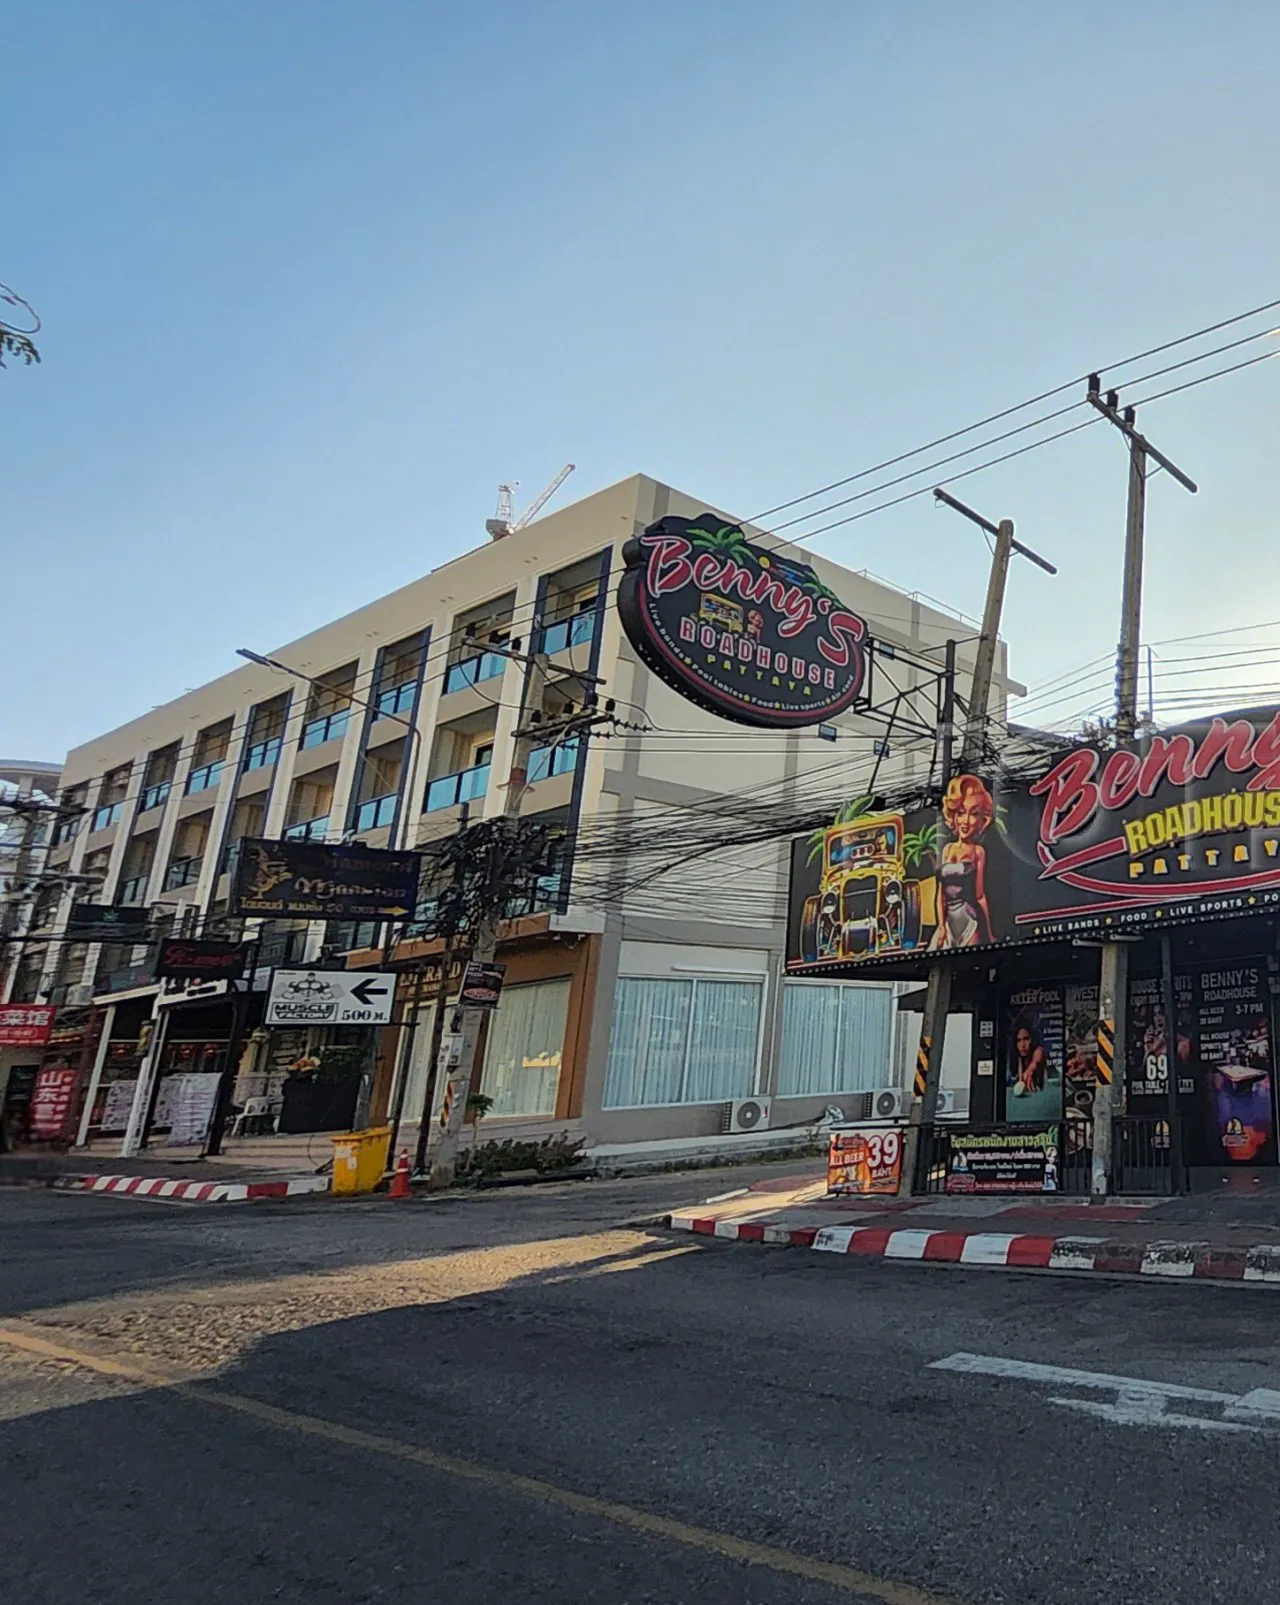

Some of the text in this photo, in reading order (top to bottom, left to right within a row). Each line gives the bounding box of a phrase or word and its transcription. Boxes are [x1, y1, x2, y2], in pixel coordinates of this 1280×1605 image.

[648, 602, 686, 659] Live bands
[680, 617, 836, 690] ROADHOUSE
[692, 662, 744, 700] Pool tables
[706, 653, 812, 696] PATTAYA
[751, 696, 775, 709] Food
[830, 691, 842, 702] Air
[781, 700, 826, 712] Live sports
[1169, 898, 1243, 917] LIVE SPORTS
[1121, 911, 1148, 923] FOOD
[1043, 918, 1100, 935] LIVE BANDS
[400, 961, 460, 986] EMRAD
[1201, 968, 1259, 989] BENNY'S
[1038, 990, 1061, 1003] POOL
[1075, 986, 1099, 1001] WEST
[1203, 986, 1258, 1002] ROADHOUSE
[274, 1004, 336, 1012] MUSCLE
[1210, 1006, 1225, 1014] BEER
[1235, 1003, 1264, 1015] 3-7 PM
[278, 1012, 331, 1020] FACTORY
[341, 1009, 372, 1021] 500
[1200, 1031, 1230, 1041] ALL HOUSE
[1200, 1042, 1221, 1051] SPIRITS
[1146, 1054, 1168, 1080] 69
[867, 1133, 899, 1168] 39
[844, 1152, 865, 1164] BEER
[872, 1166, 892, 1178] BAHT
